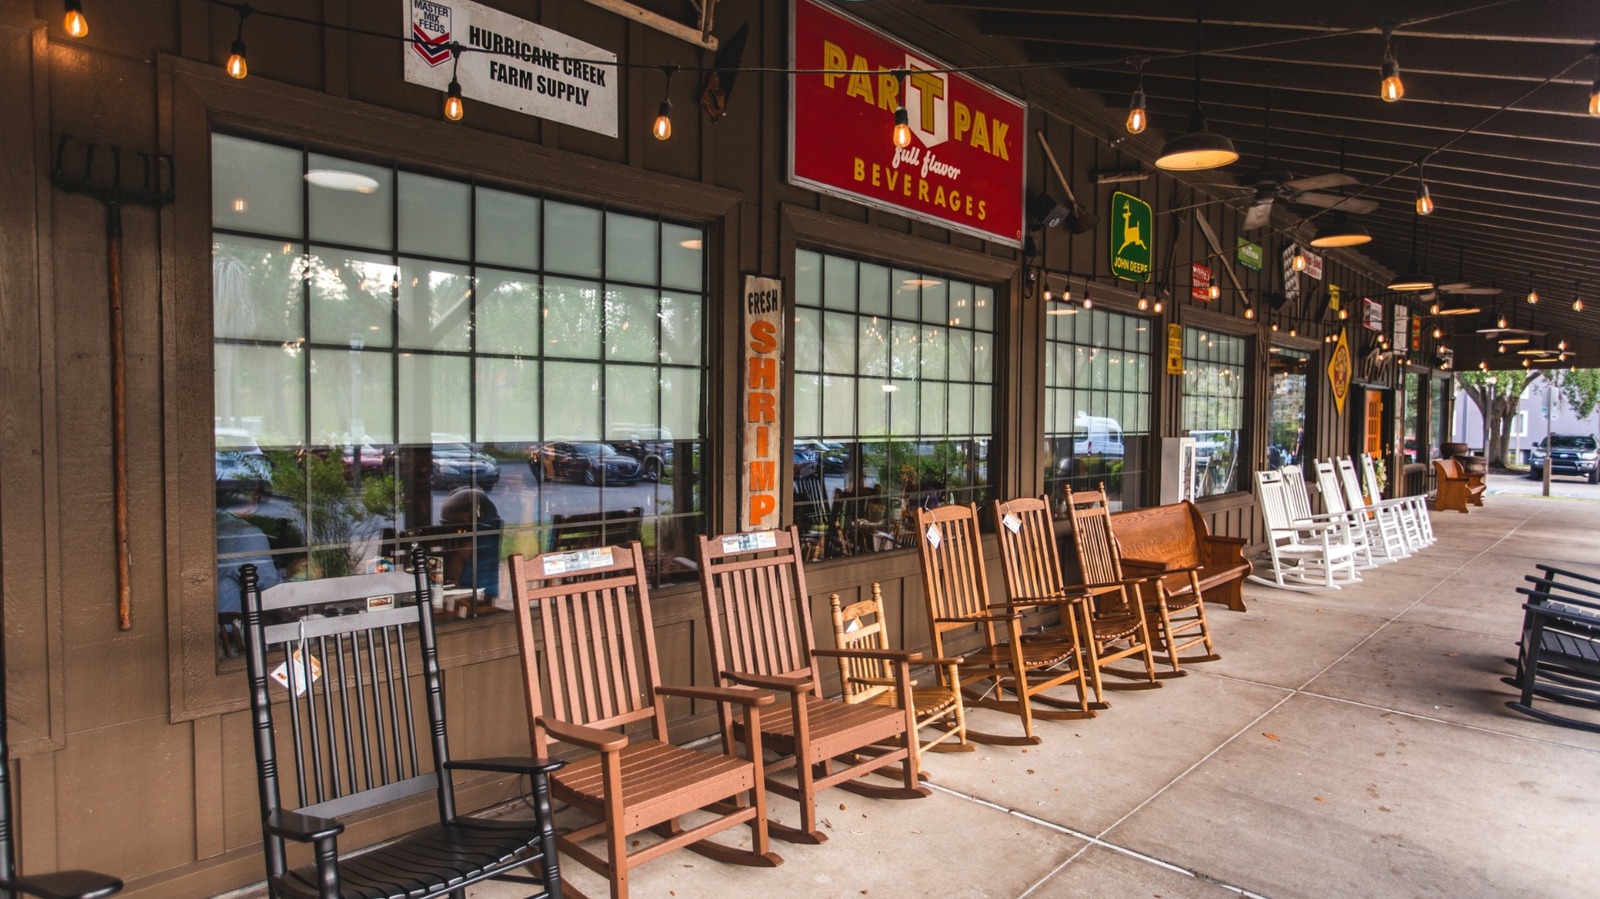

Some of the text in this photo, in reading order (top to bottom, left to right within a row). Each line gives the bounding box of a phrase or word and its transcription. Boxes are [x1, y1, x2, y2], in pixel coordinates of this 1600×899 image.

[414, 0, 449, 17] MASTER
[424, 12, 440, 23] MIX
[419, 19, 446, 34] FEEDS
[469, 25, 606, 87] HURRICANE CREEK
[490, 61, 589, 107] FARM SUPPLY
[954, 100, 1010, 161] PAK
[892, 146, 961, 180] full flavor
[854, 157, 987, 221] BEVERAGES
[1114, 256, 1130, 271] JOHN
[748, 289, 778, 315] FRESH
[748, 320, 777, 527] SHRIMP
